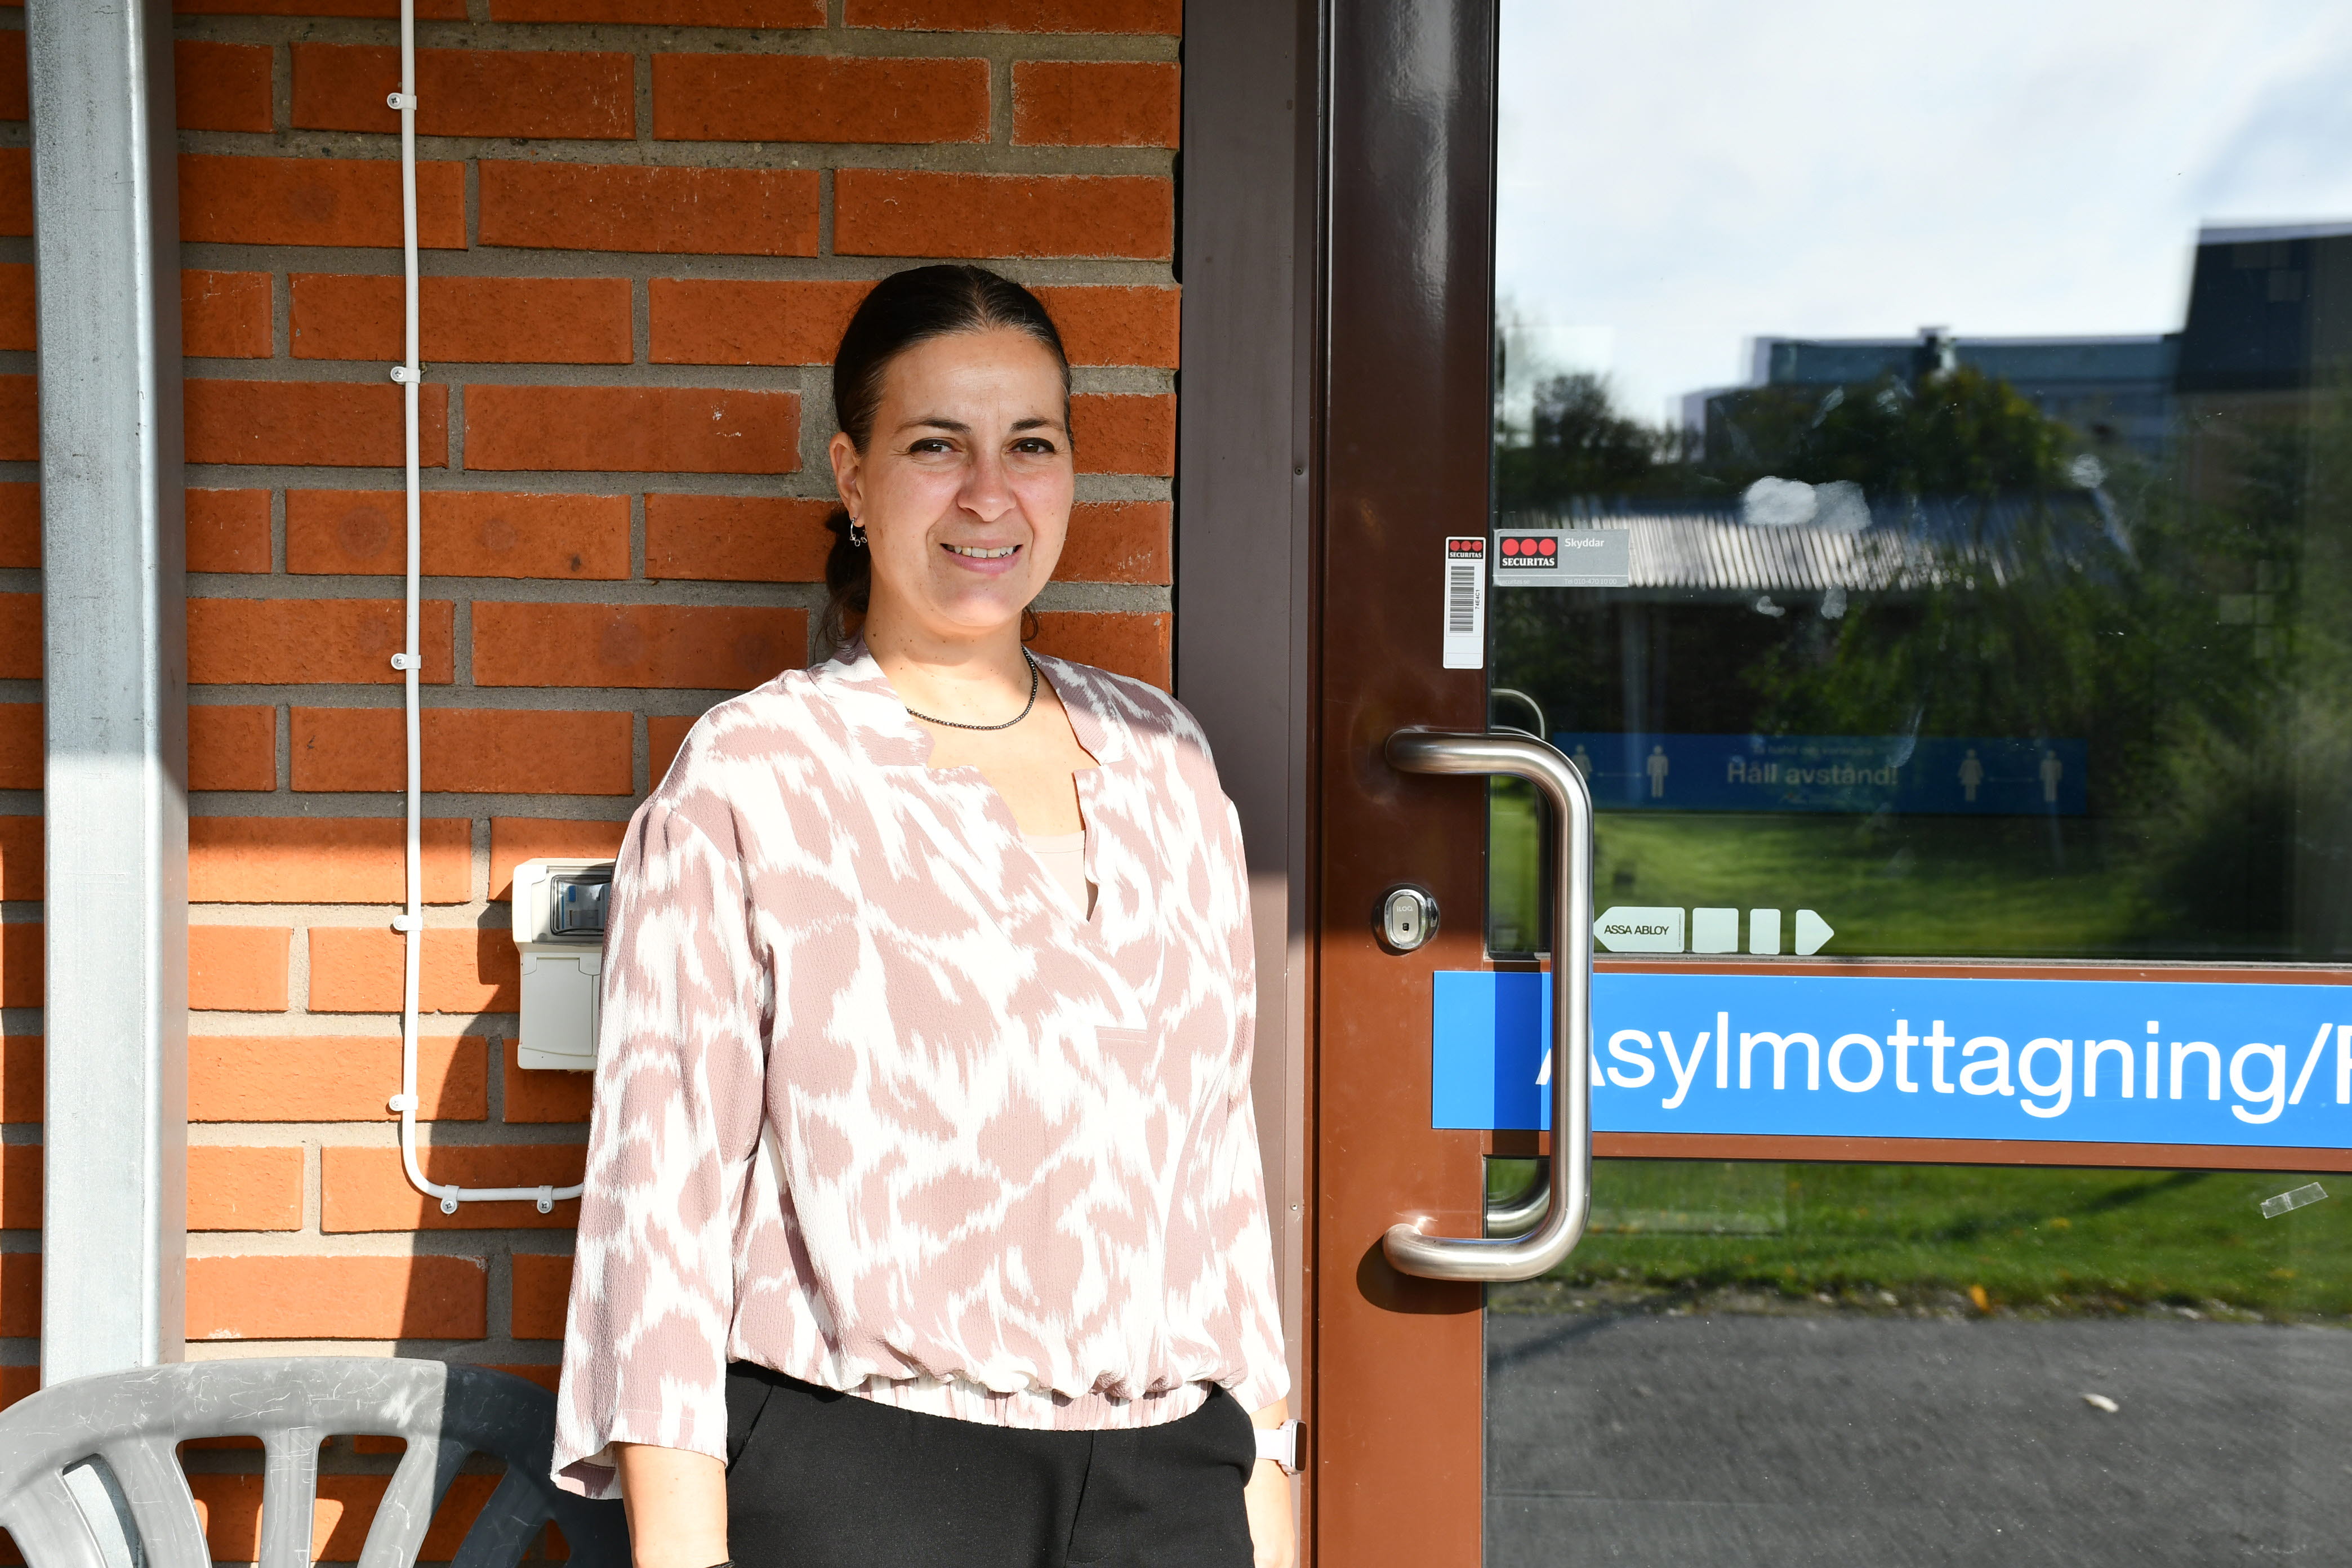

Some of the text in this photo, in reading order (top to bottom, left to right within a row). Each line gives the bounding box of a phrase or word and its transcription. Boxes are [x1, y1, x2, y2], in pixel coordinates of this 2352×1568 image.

[1565, 538, 1605, 548] Skyddar
[1502, 558, 1555, 567] SECURITAS
[1727, 761, 1899, 786] Håll avstånd!
[1604, 925, 1669, 936] ASSA ABLOY
